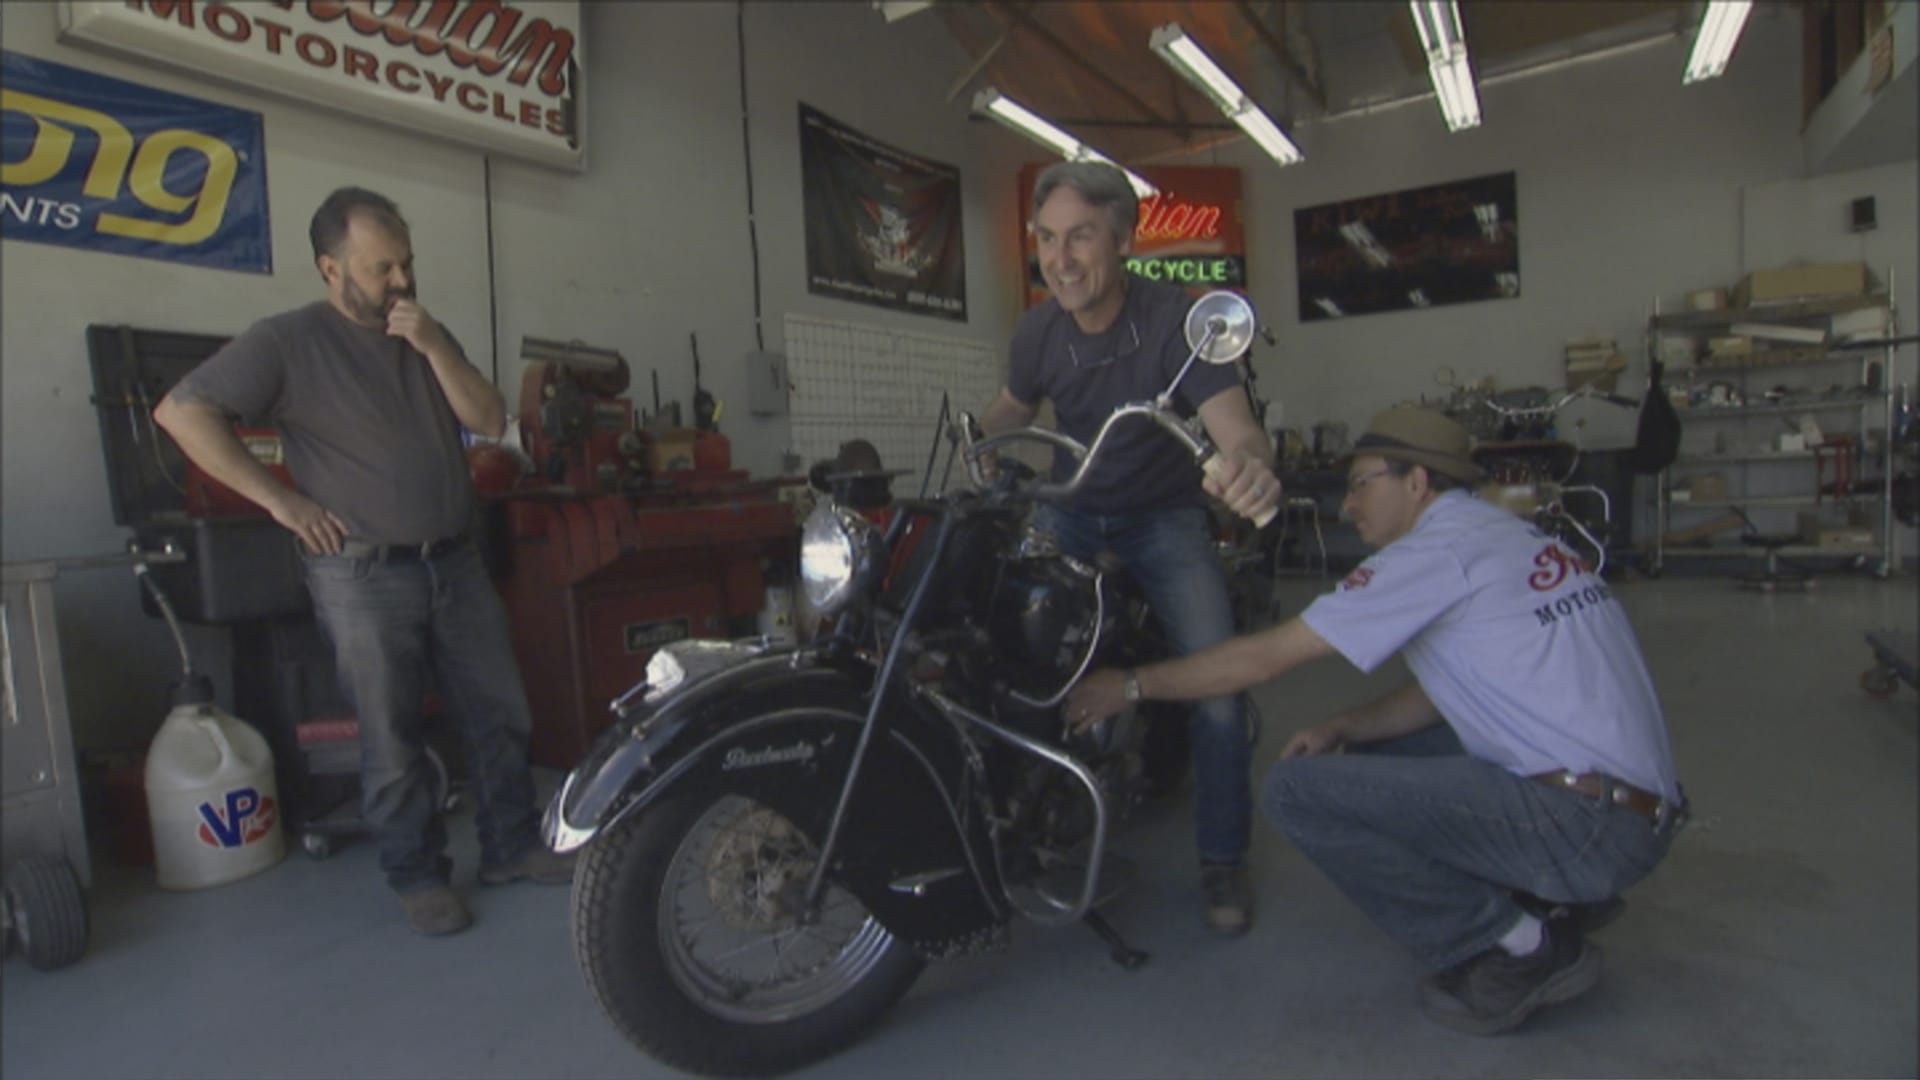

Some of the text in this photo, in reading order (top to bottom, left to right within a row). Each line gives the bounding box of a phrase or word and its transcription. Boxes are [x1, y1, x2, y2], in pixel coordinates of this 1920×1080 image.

[125, 0, 567, 137] MOTORCYCLES
[1125, 257, 1229, 282] RCYCLE
[198, 787, 260, 849] VP
